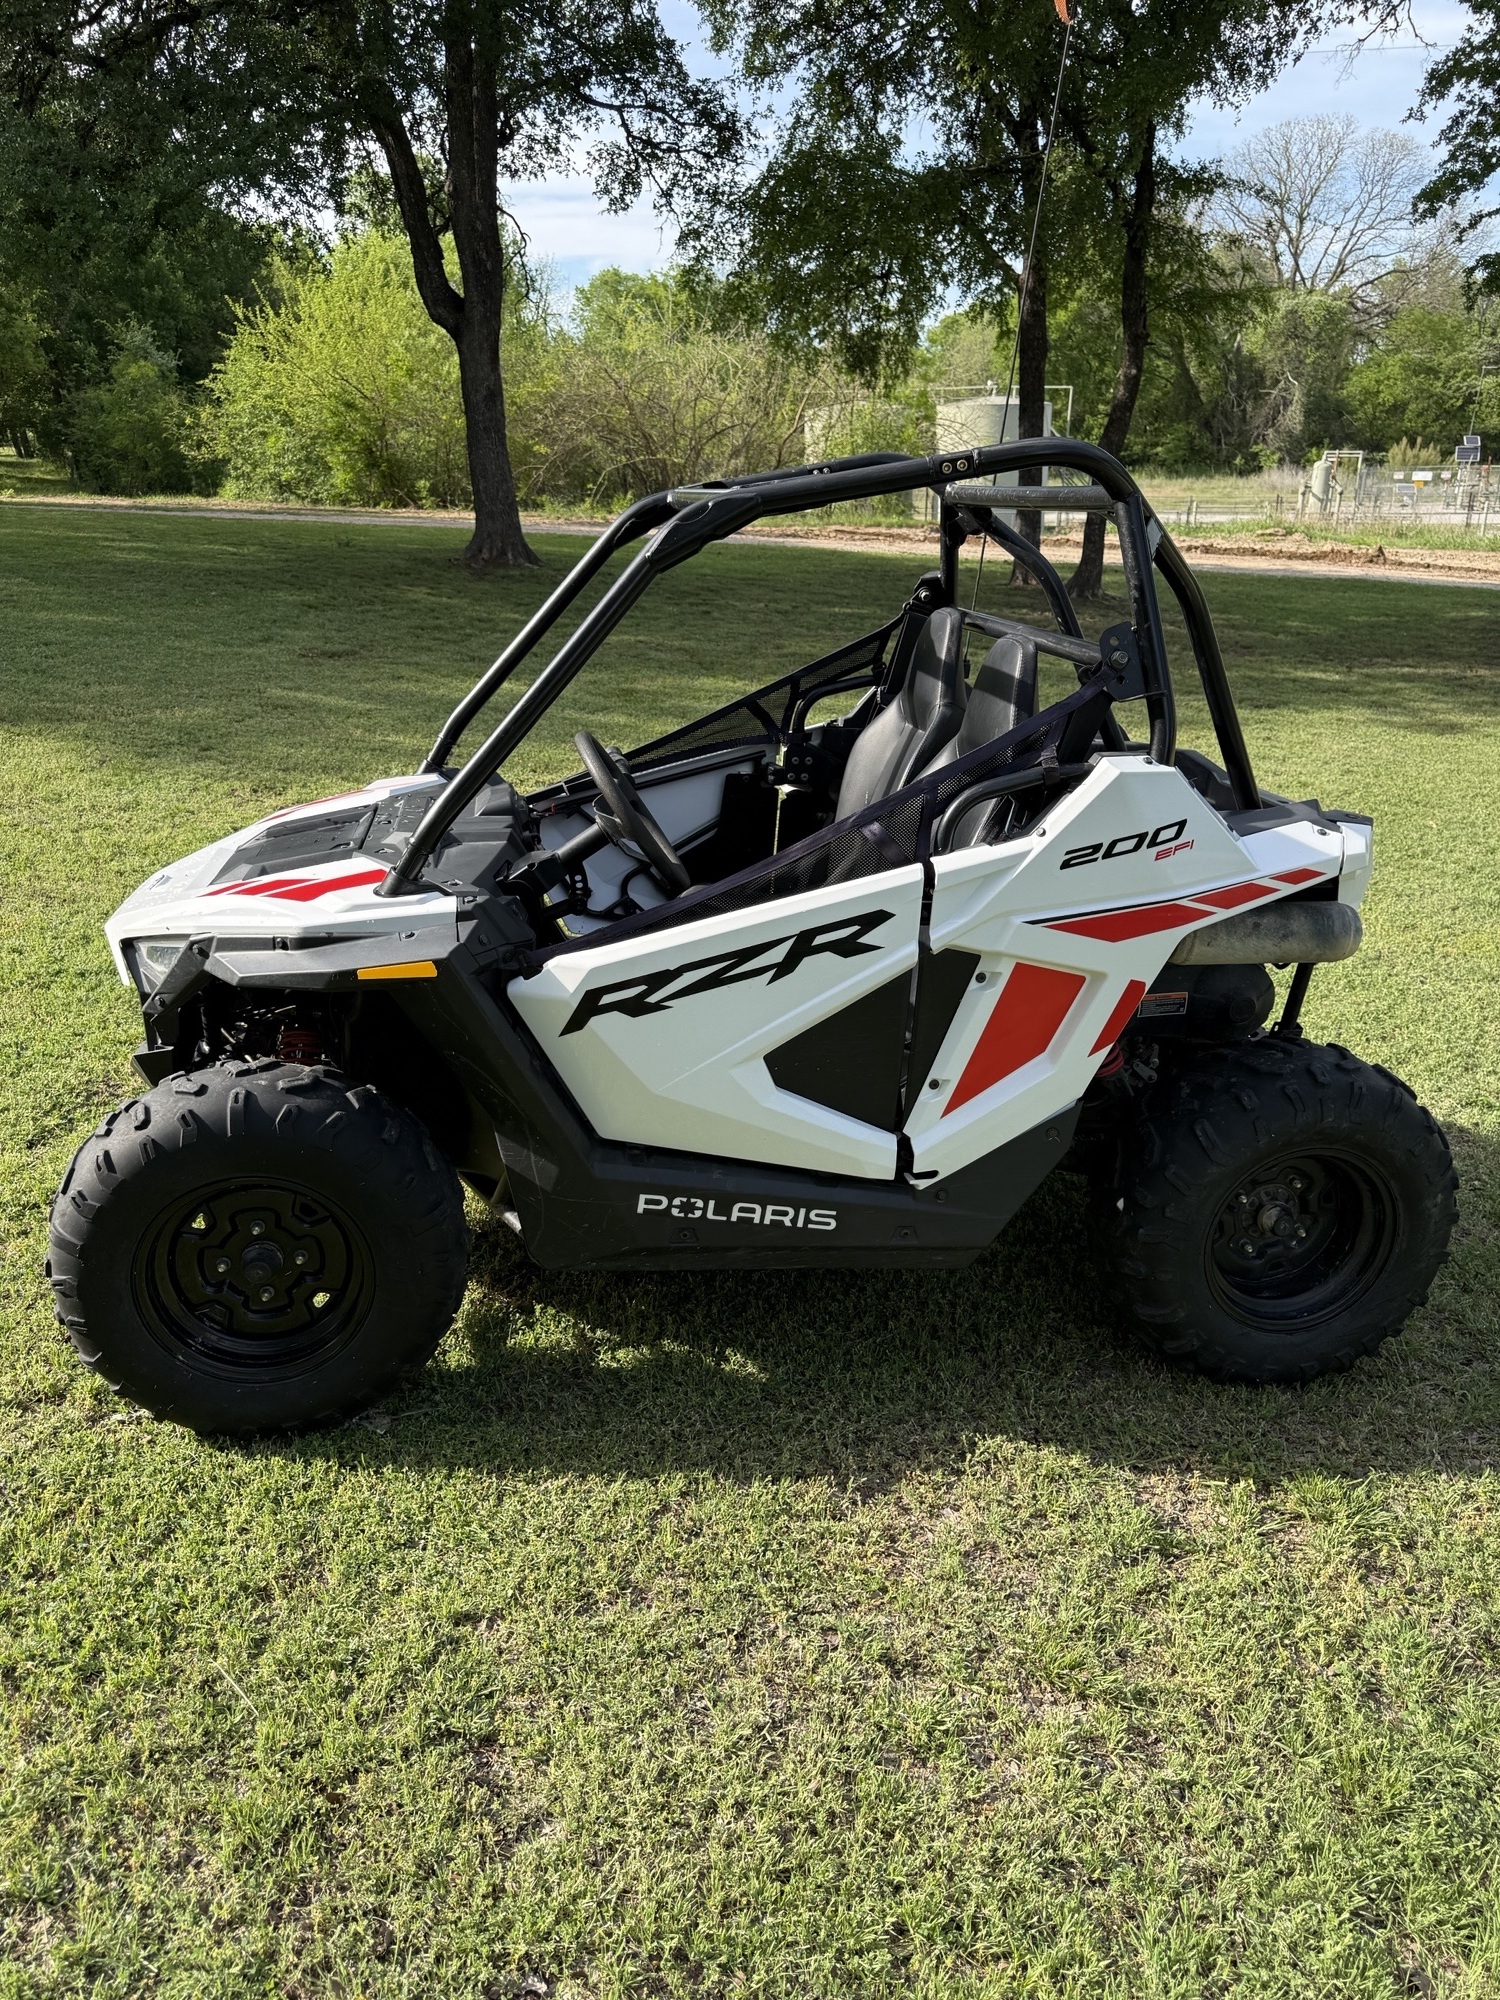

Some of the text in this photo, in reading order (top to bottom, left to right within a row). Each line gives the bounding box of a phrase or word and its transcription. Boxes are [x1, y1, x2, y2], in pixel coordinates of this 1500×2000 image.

[1060, 818, 1187, 870] 200
[1154, 839, 1194, 861] EFI
[558, 909, 896, 1037] RZR
[637, 1194, 837, 1230] POLARIS
